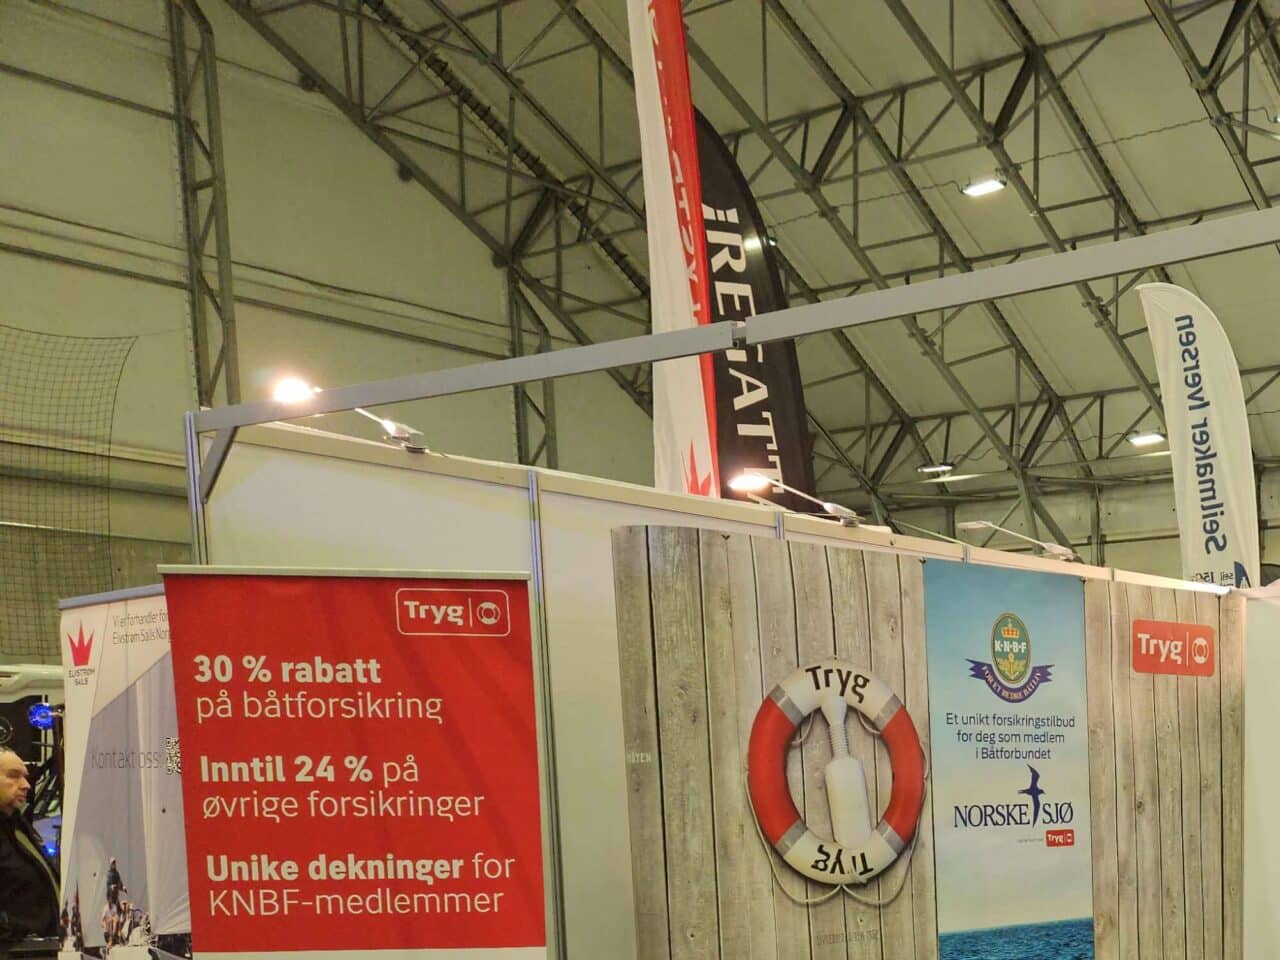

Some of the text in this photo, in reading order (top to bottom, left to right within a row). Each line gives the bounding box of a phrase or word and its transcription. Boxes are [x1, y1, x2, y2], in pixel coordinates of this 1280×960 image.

[404, 600, 464, 626] Tryg
[1137, 632, 1183, 665] Tryg
[193, 655, 382, 684] 30 % rabatt
[805, 665, 870, 704] Tryg
[197, 690, 443, 724] på båtforsikring
[946, 713, 1075, 729] Et unikt forsikringstilbud
[957, 730, 1065, 744] for deg som medlem
[981, 746, 1051, 759] Båtforbundet
[200, 754, 419, 788] Inntil 24 % på
[203, 790, 485, 823] øvrige forsikringer
[954, 801, 1074, 828] NORSKE SJØ
[1048, 834, 1063, 844] Tryg
[206, 852, 515, 886] Unike dekninger for
[209, 888, 504, 917] KNBF-medlemmer
